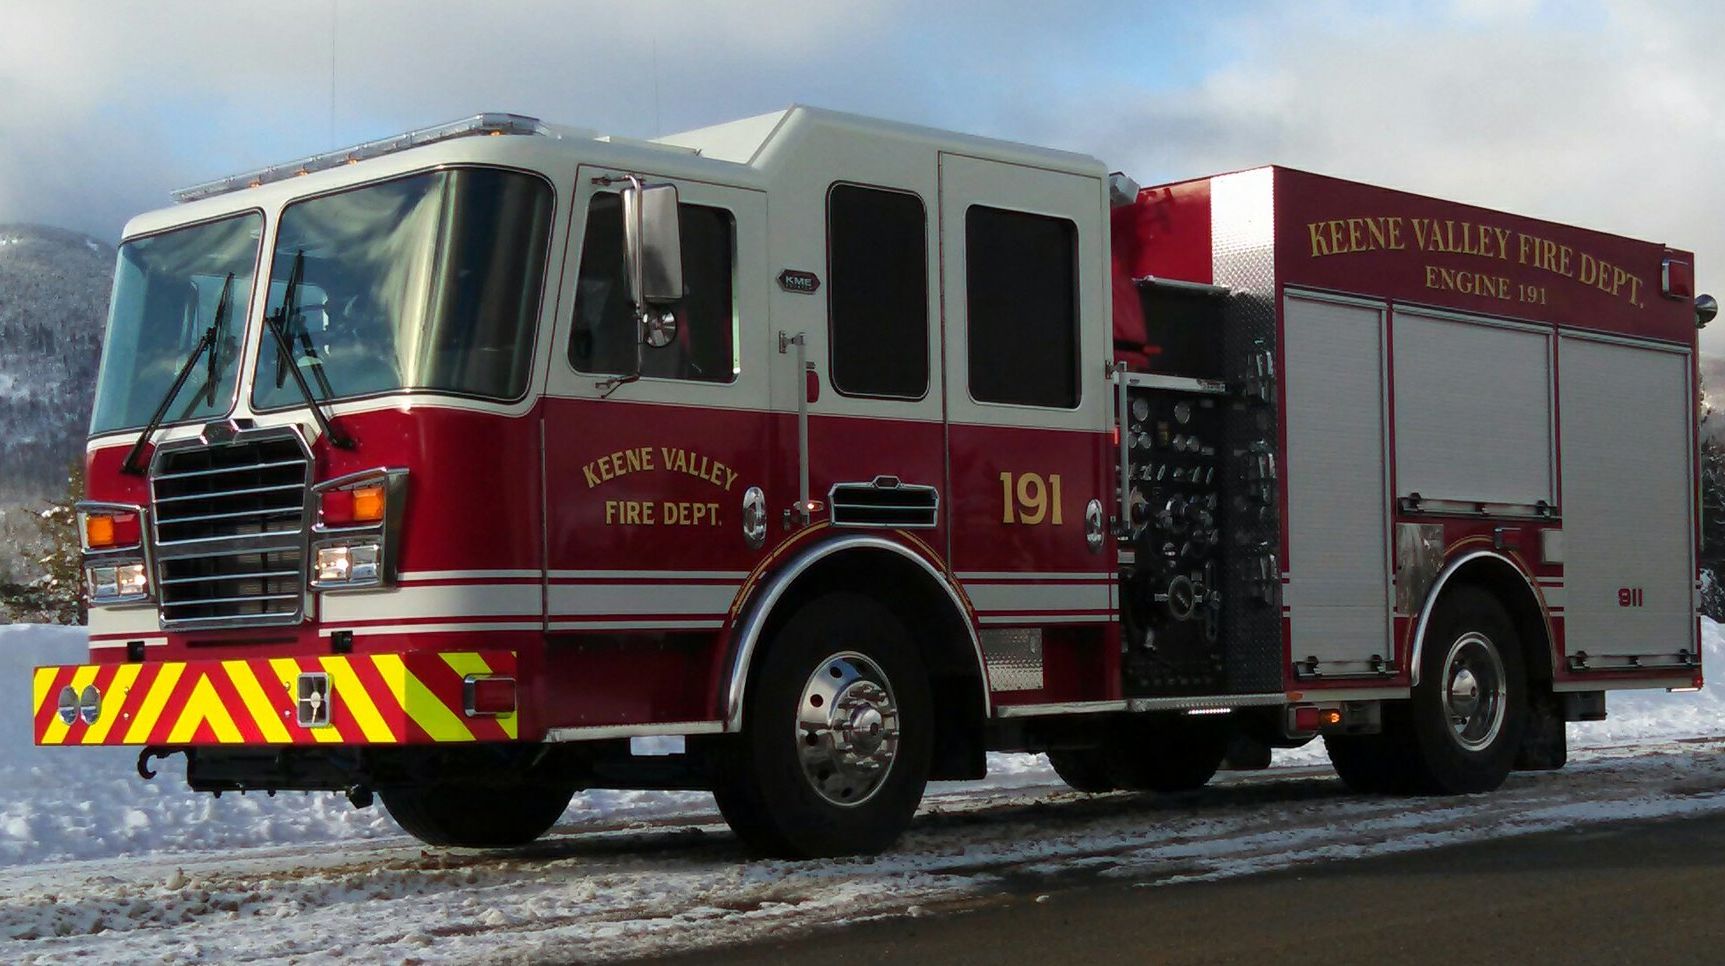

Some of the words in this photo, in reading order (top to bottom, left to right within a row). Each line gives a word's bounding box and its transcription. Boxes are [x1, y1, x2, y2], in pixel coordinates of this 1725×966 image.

[785, 275, 812, 286] KME
[1307, 217, 1405, 257] KEENE
[1411, 218, 1511, 260] VALLEY
[1518, 233, 1573, 277] FIRE
[1578, 252, 1644, 309] DEPT.
[1425, 265, 1511, 300] ENGINE
[1519, 284, 1546, 305] 191
[582, 447, 655, 489] KEENE
[661, 447, 738, 492] VALLEY
[605, 500, 655, 525] FIRE
[663, 501, 722, 527] DEPT.
[1000, 472, 1063, 525] 191
[1618, 588, 1643, 607] 911
